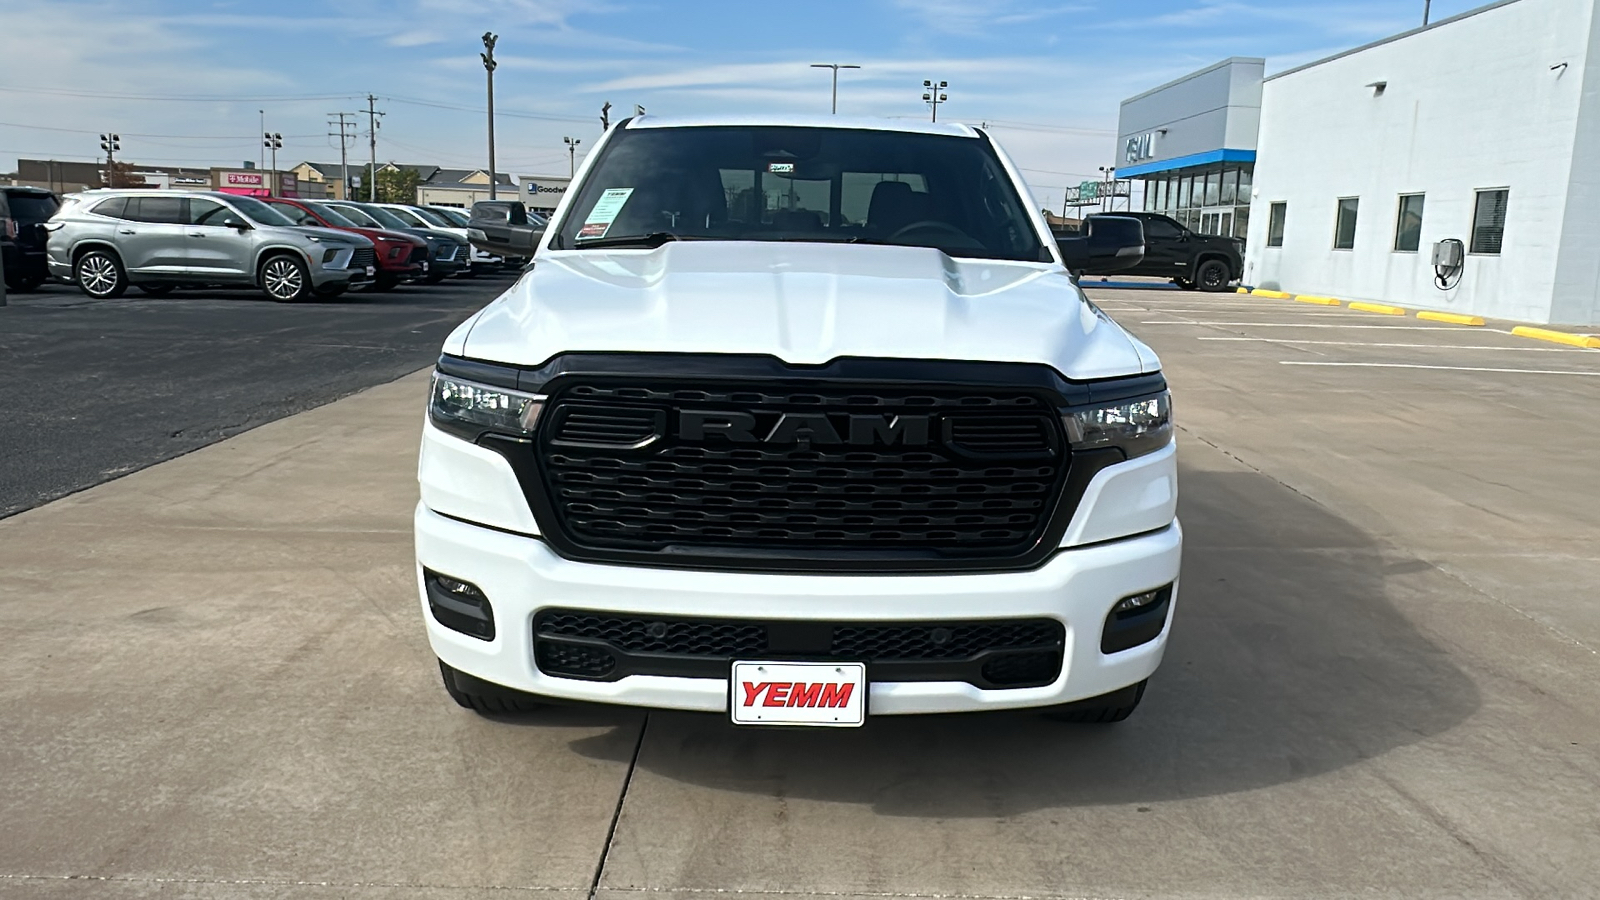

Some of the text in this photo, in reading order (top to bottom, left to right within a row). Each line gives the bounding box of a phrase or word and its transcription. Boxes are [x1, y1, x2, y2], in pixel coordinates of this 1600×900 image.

[537, 185, 568, 194] Goodwi
[679, 409, 929, 445] RAM
[742, 682, 855, 708] YEMM
